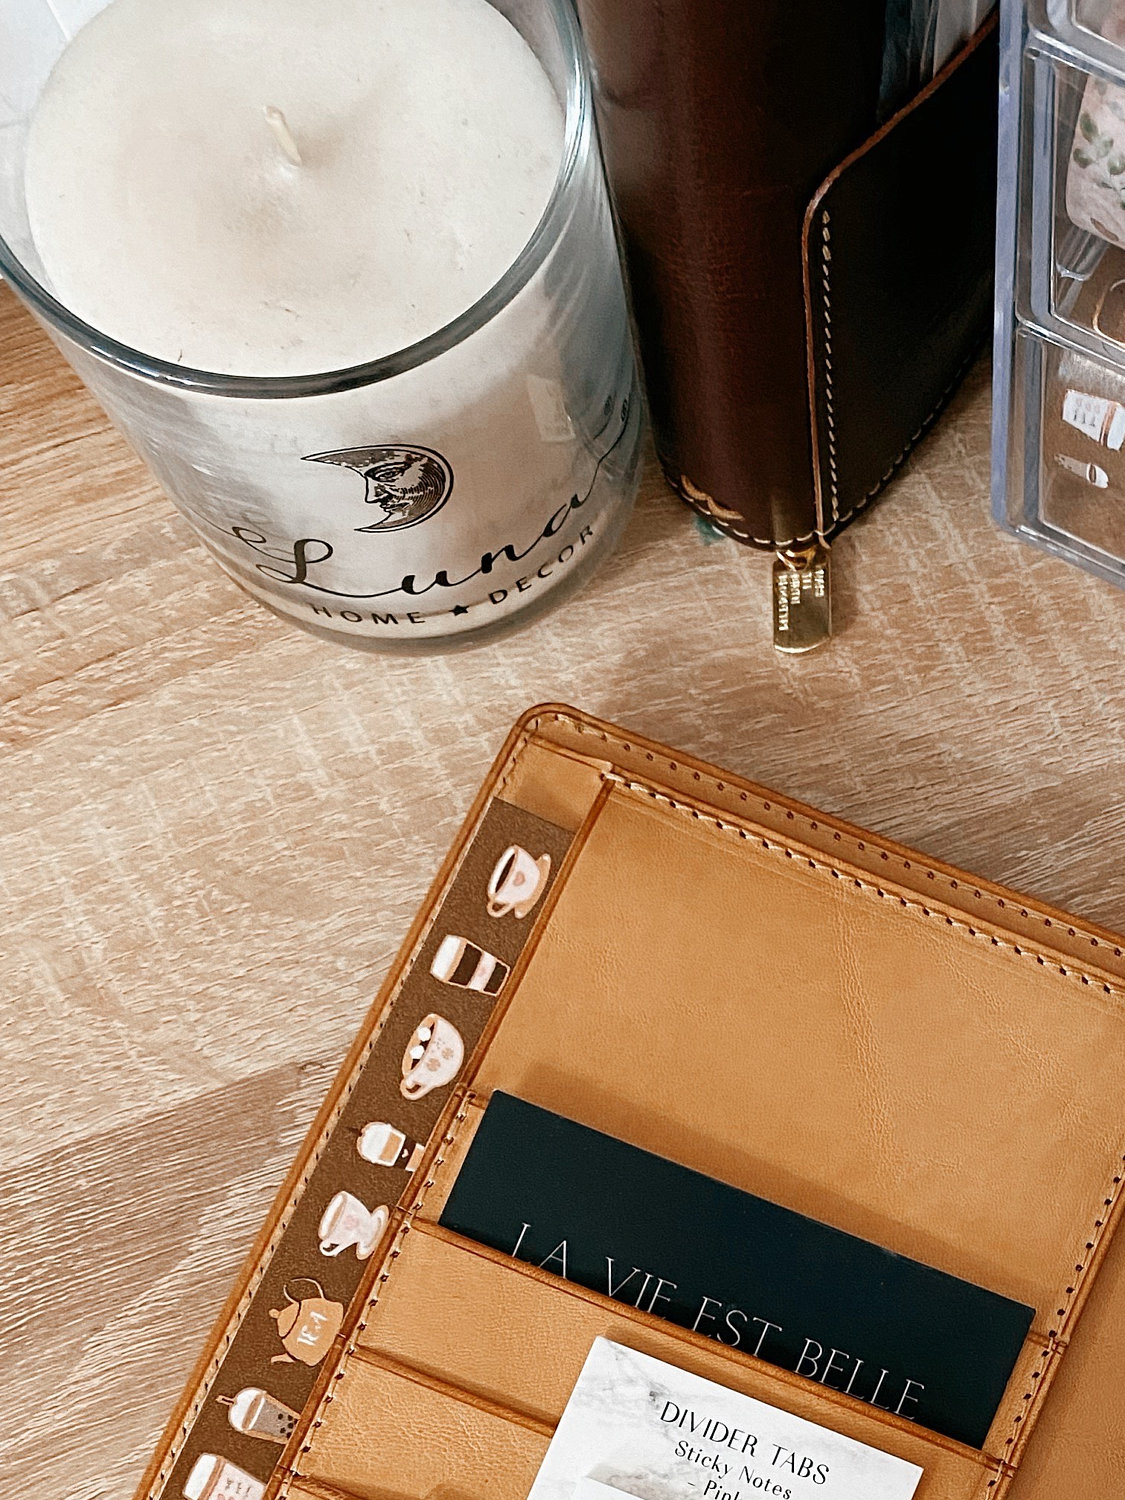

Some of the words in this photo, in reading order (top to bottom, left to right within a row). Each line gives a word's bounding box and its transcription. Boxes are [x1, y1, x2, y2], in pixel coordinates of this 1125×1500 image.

[309, 602, 426, 626] HOME
[488, 524, 595, 606] DECOR
[511, 1222, 568, 1279] LA
[604, 1256, 678, 1320] VIE
[692, 1296, 783, 1357] EST
[794, 1338, 926, 1420] BELLE
[660, 1401, 758, 1458] DIVIDER
[771, 1443, 830, 1485] TABS
[674, 1441, 732, 1479] Sticky
[738, 1465, 793, 1500] Notes
